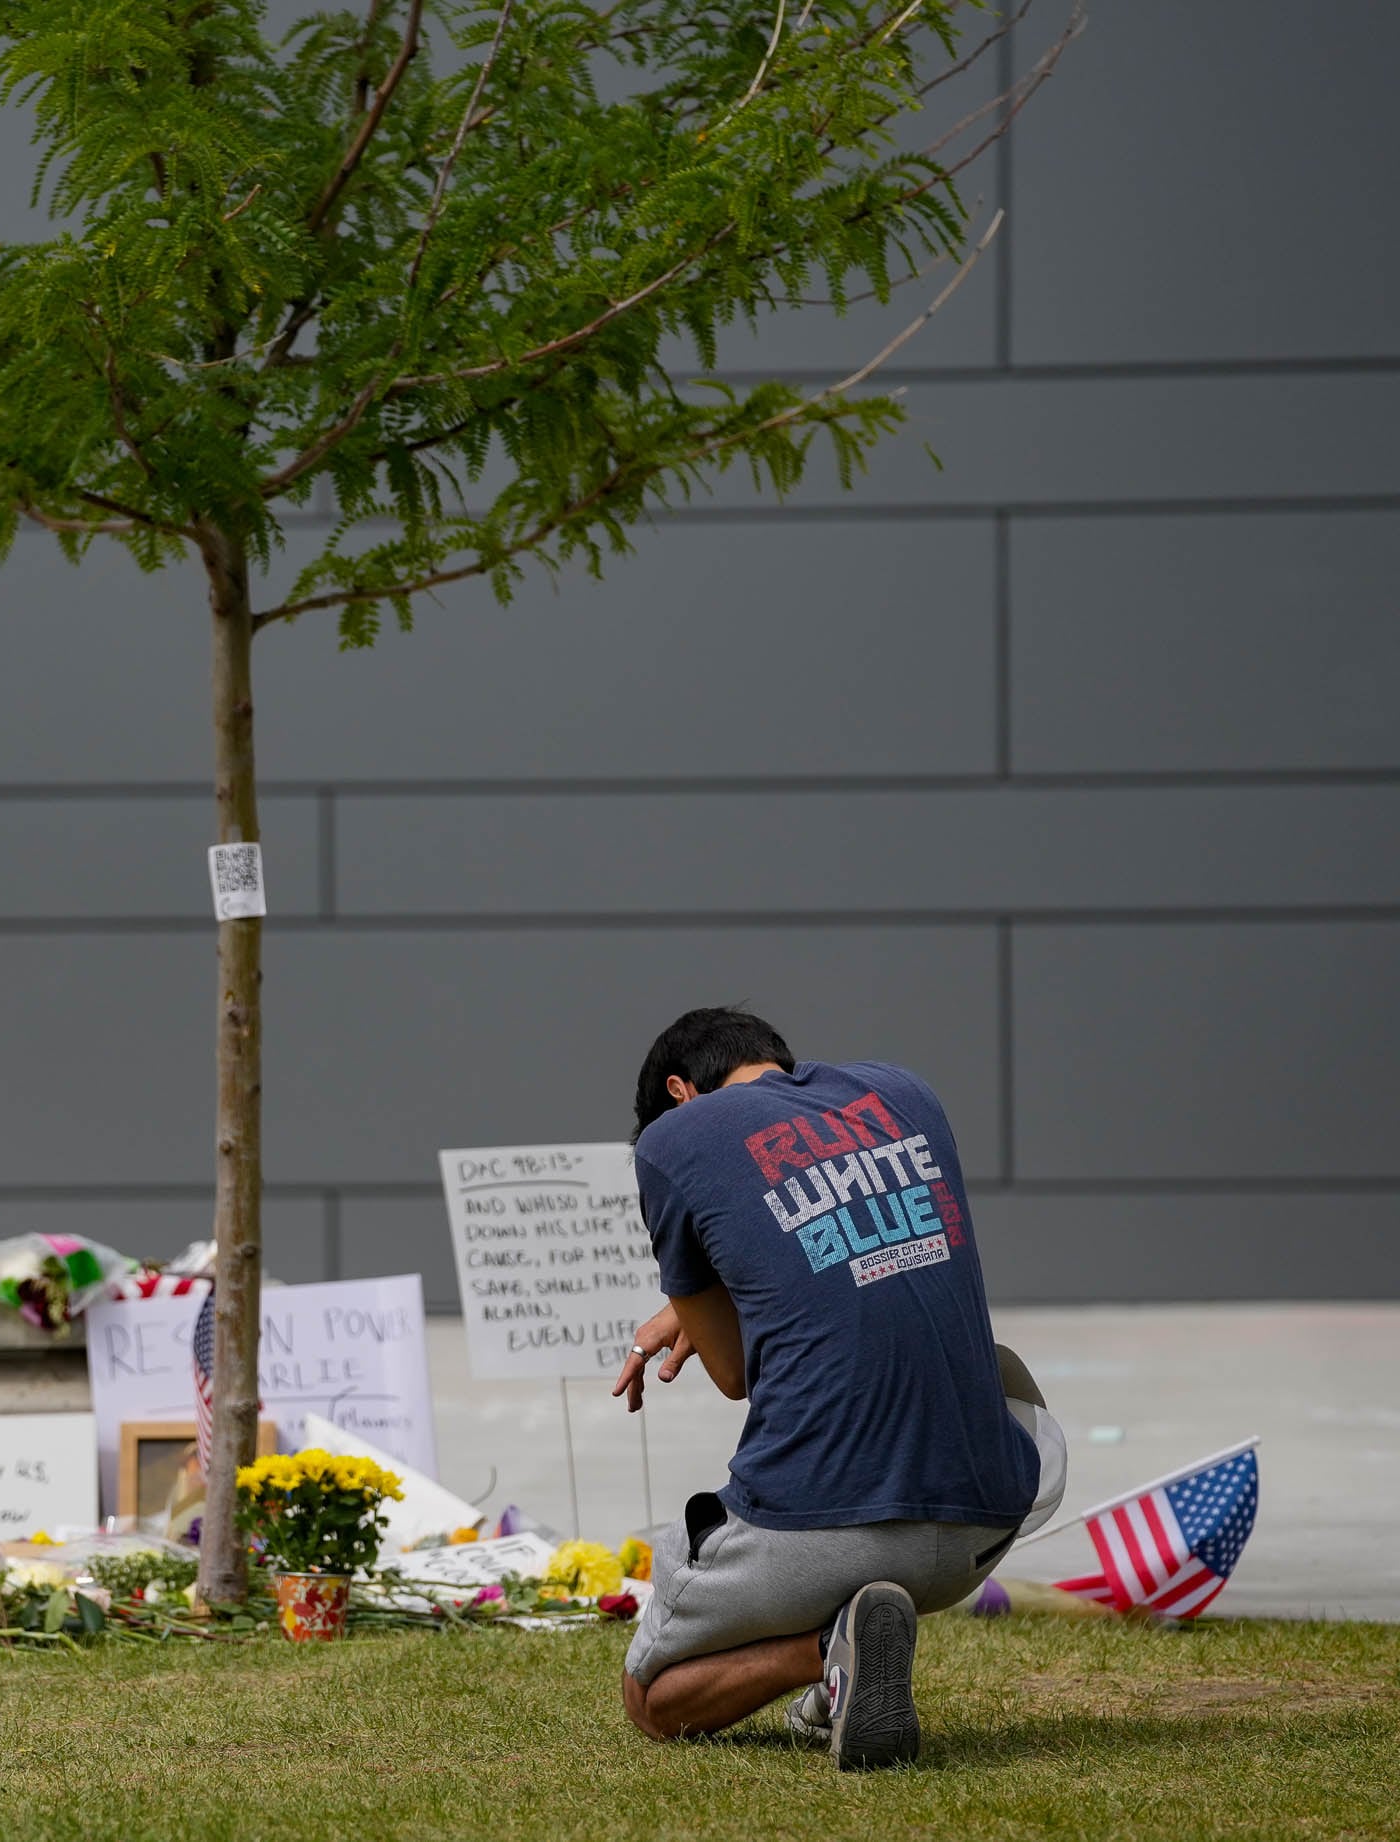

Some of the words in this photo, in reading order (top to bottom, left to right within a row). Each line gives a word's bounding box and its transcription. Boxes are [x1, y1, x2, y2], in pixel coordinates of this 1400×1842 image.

[744, 1091, 902, 1187] RUN
[763, 1134, 942, 1232] WHITE
[464, 1196, 506, 1215] AND
[464, 1222, 528, 1242] DOWN
[535, 1219, 568, 1240] HIS
[571, 1217, 614, 1236] LIFE
[796, 1184, 942, 1274] BLUE
[548, 1246, 585, 1266] FOR
[859, 1248, 902, 1270] BOSSIER
[901, 1242, 928, 1257] CITY,
[895, 1248, 946, 1270] LOUISIANA
[534, 1277, 591, 1296] SHALL
[591, 1271, 641, 1290] FIND
[505, 1321, 586, 1353] EVEN
